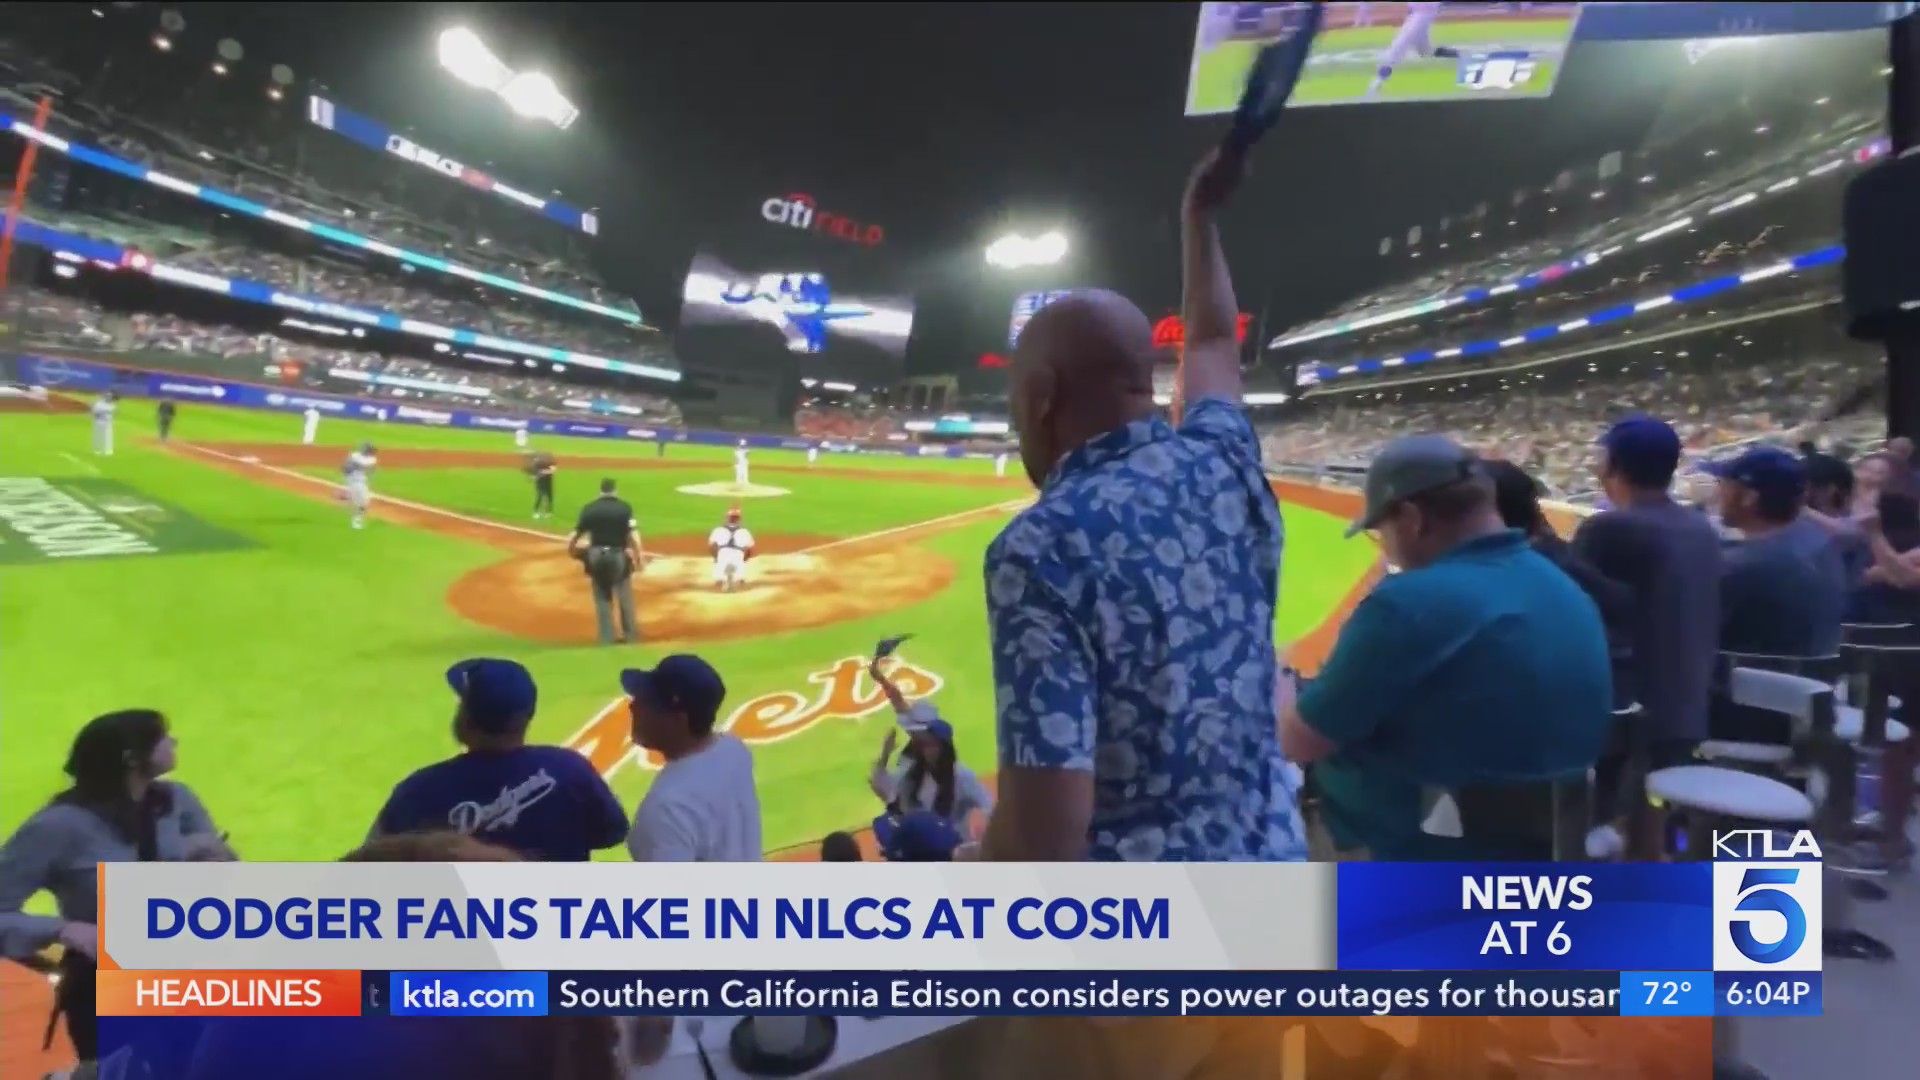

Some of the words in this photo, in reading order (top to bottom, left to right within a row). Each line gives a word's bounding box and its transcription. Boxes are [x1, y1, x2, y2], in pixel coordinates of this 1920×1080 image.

[761, 192, 815, 229] citi
[815, 211, 883, 247] FIELD
[447, 767, 557, 835] Dodgers
